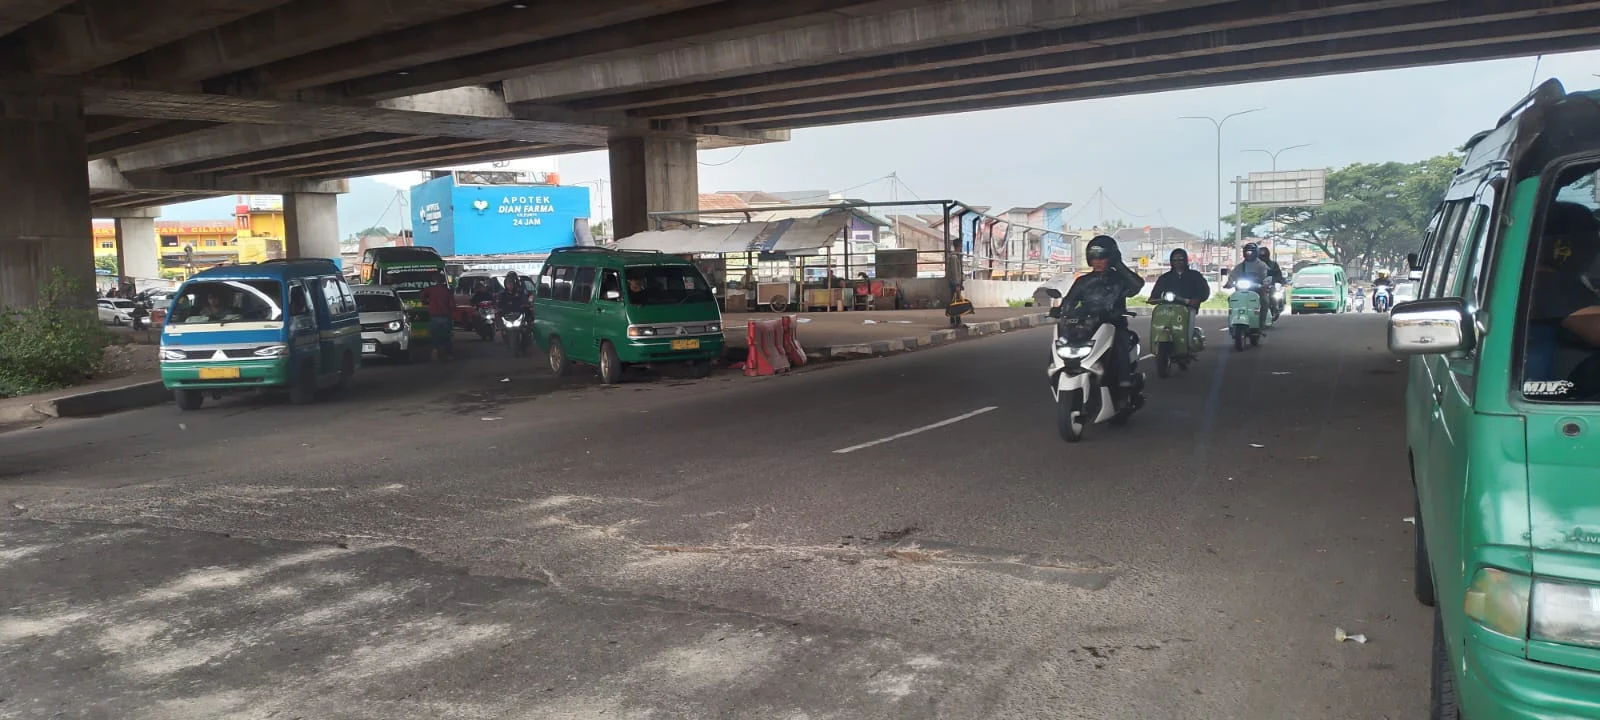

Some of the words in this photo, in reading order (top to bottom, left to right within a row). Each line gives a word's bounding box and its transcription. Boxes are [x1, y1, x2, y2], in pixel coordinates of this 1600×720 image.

[502, 196, 550, 204] APOTEK
[498, 205, 521, 213] DIAN
[523, 204, 554, 213] FARMA
